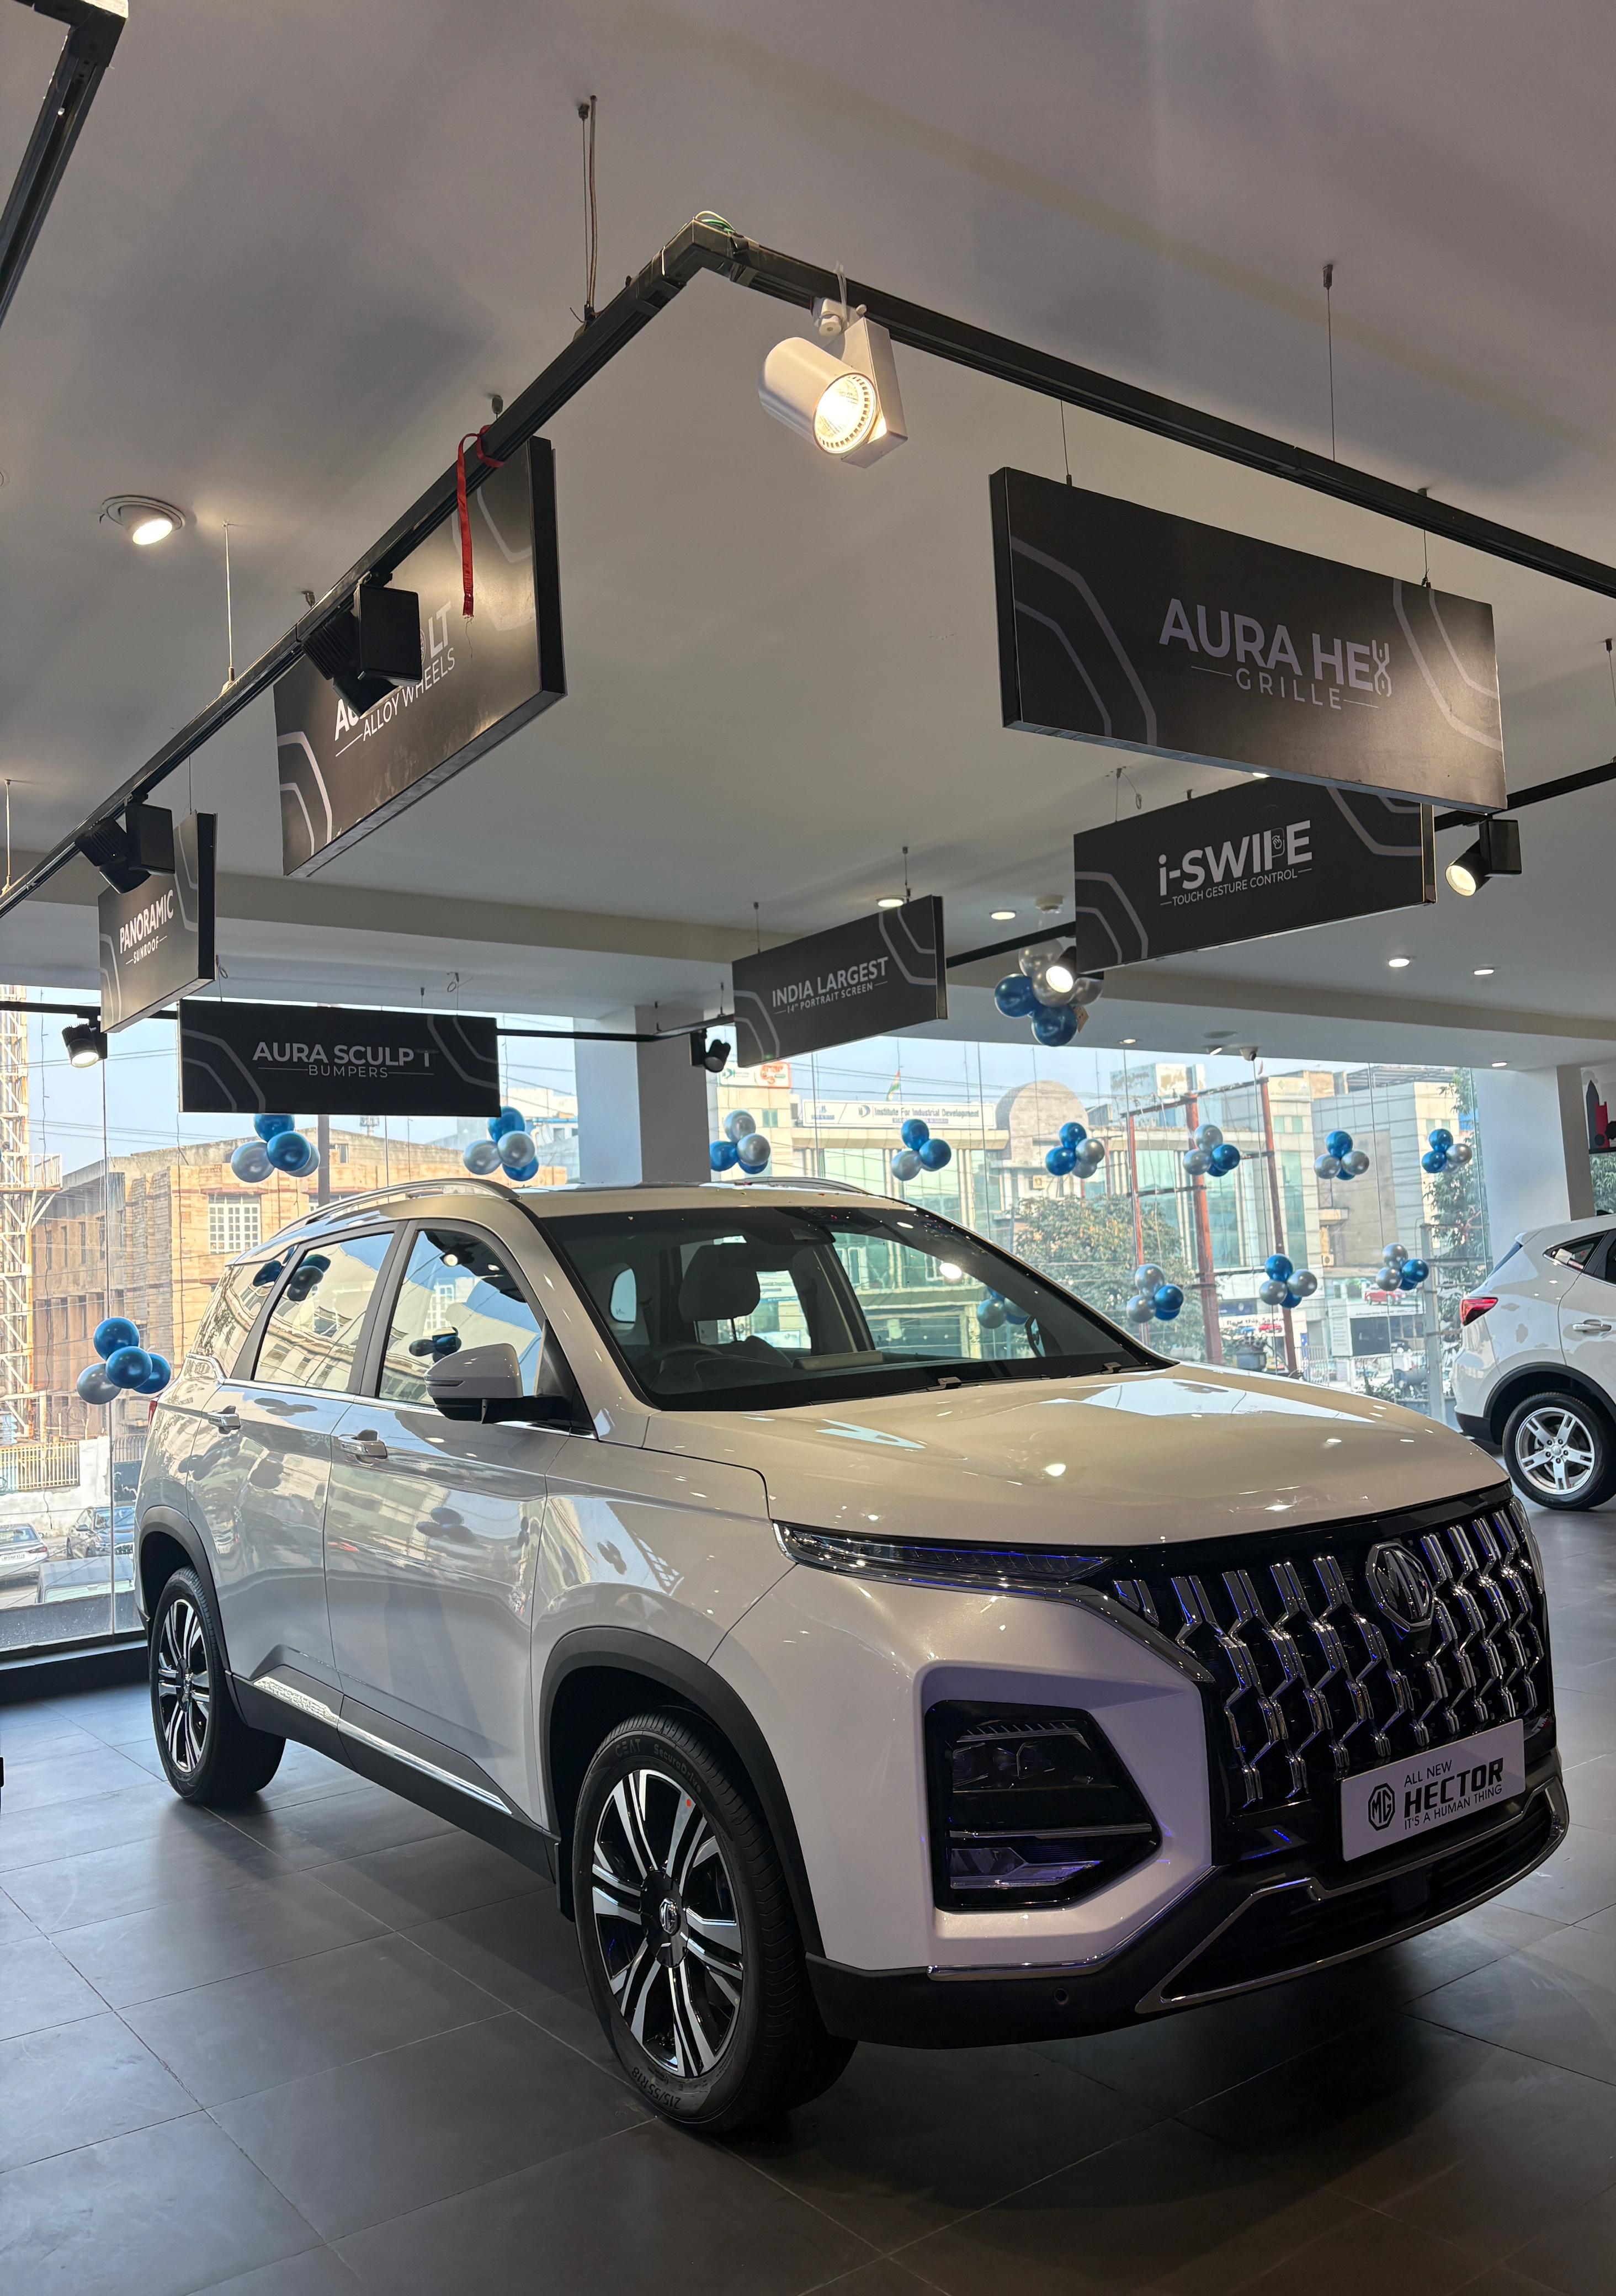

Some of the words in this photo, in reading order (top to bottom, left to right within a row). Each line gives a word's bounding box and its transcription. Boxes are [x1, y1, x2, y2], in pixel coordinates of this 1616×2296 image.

[1159, 598, 1303, 676] AURA
[1312, 633, 1392, 697] HEX
[363, 692, 400, 742] ALLOY
[401, 647, 455, 708] WHEELS
[1236, 667, 1342, 710] GRILLE
[1172, 890, 1203, 906] TOUCH
[1205, 879, 1247, 899] GESTURE
[1250, 868, 1298, 888] CONTROL
[120, 889, 174, 954] PANORAMIC
[133, 936, 159, 964] SUNROOF
[772, 980, 814, 1007] INDIA
[817, 956, 889, 994] LARGEST
[800, 991, 839, 1010] PORTRAIT
[841, 981, 873, 998] SCREEN
[252, 1041, 329, 1063] AURA
[309, 1064, 388, 1078] BUMPERS
[874, 1107, 899, 1116] Institute
[901, 1107, 910, 1116] For
[912, 1108, 940, 1117] Industrial
[942, 1108, 980, 1119] Development
[615, 1738, 641, 1758] CEAT
[1404, 1771, 1423, 1788] ALL
[1426, 1759, 1452, 1779] NEW
[1404, 1757, 1504, 1819] HECTOR
[1404, 1815, 1420, 1830] IT'S
[1423, 1812, 1431, 1824] A
[1434, 1796, 1470, 1820] HUMAN
[1474, 1784, 1502, 1804] THING
